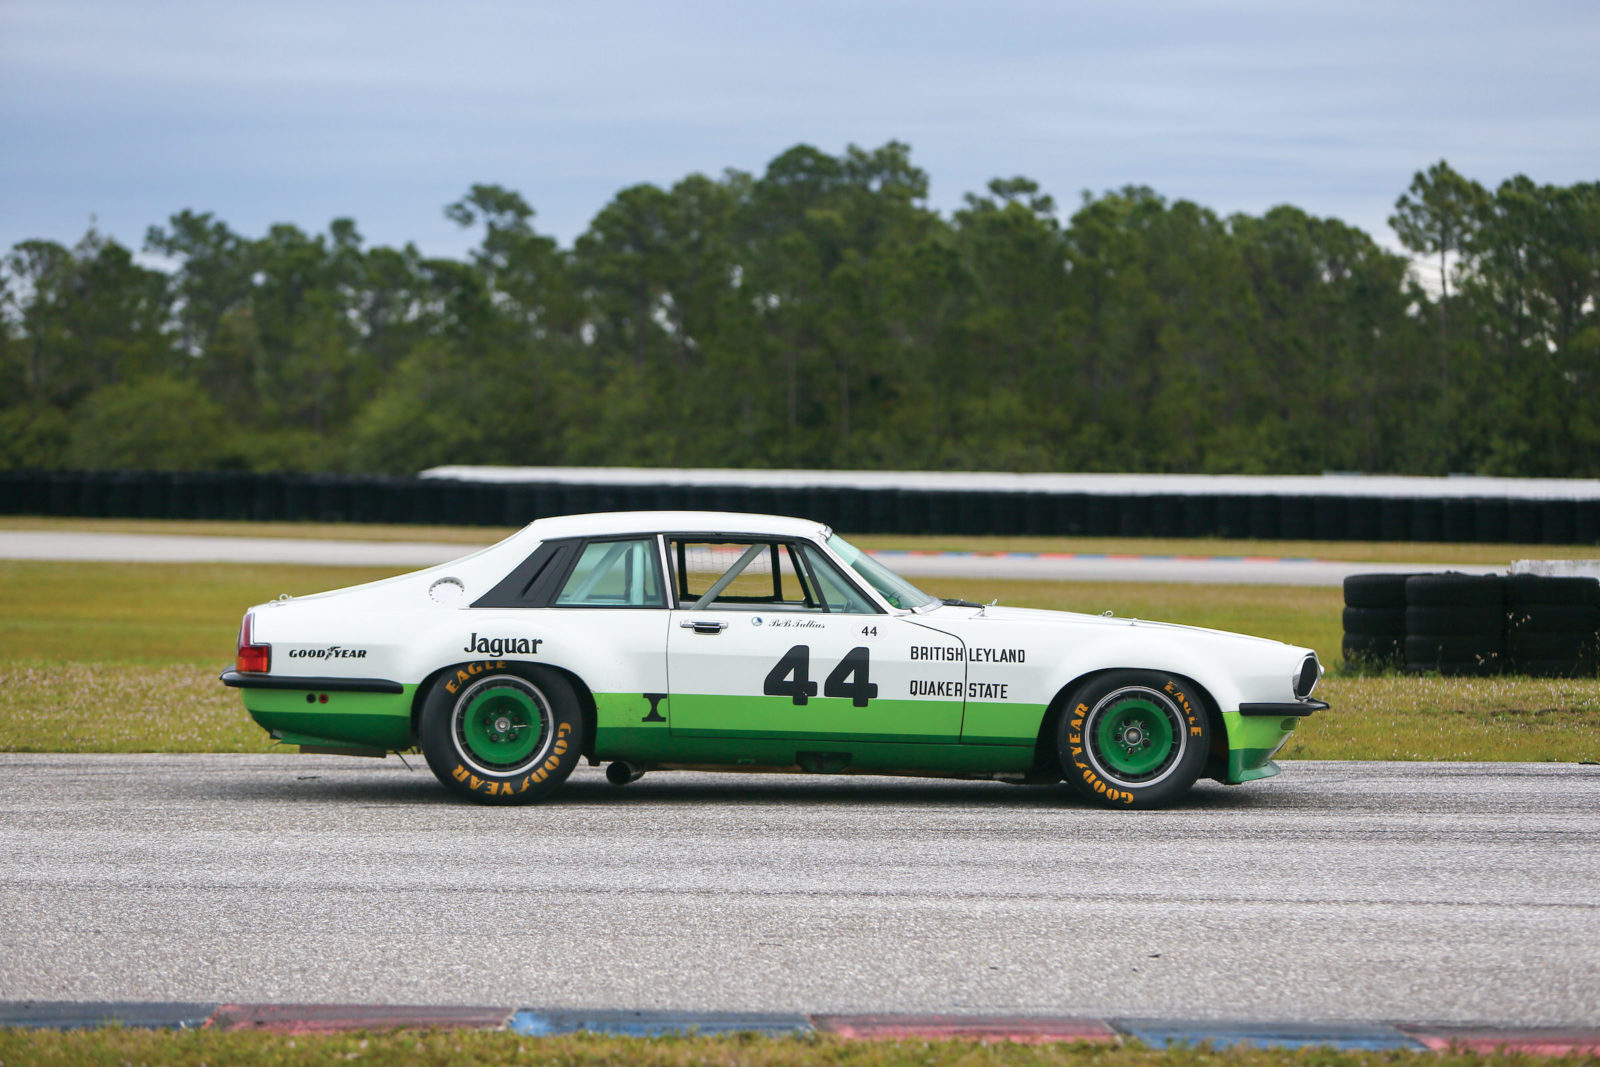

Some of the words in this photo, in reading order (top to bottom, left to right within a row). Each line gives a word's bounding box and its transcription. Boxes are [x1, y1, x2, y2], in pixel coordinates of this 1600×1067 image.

[861, 626, 878, 636] 44
[464, 633, 543, 657] Jaguar
[910, 646, 964, 662] BRITISH
[969, 648, 1026, 663] LEYLAND
[445, 661, 507, 694] EAGLE
[763, 645, 878, 707] 44
[909, 680, 963, 697] QUAKER
[968, 683, 1008, 699] STATE
